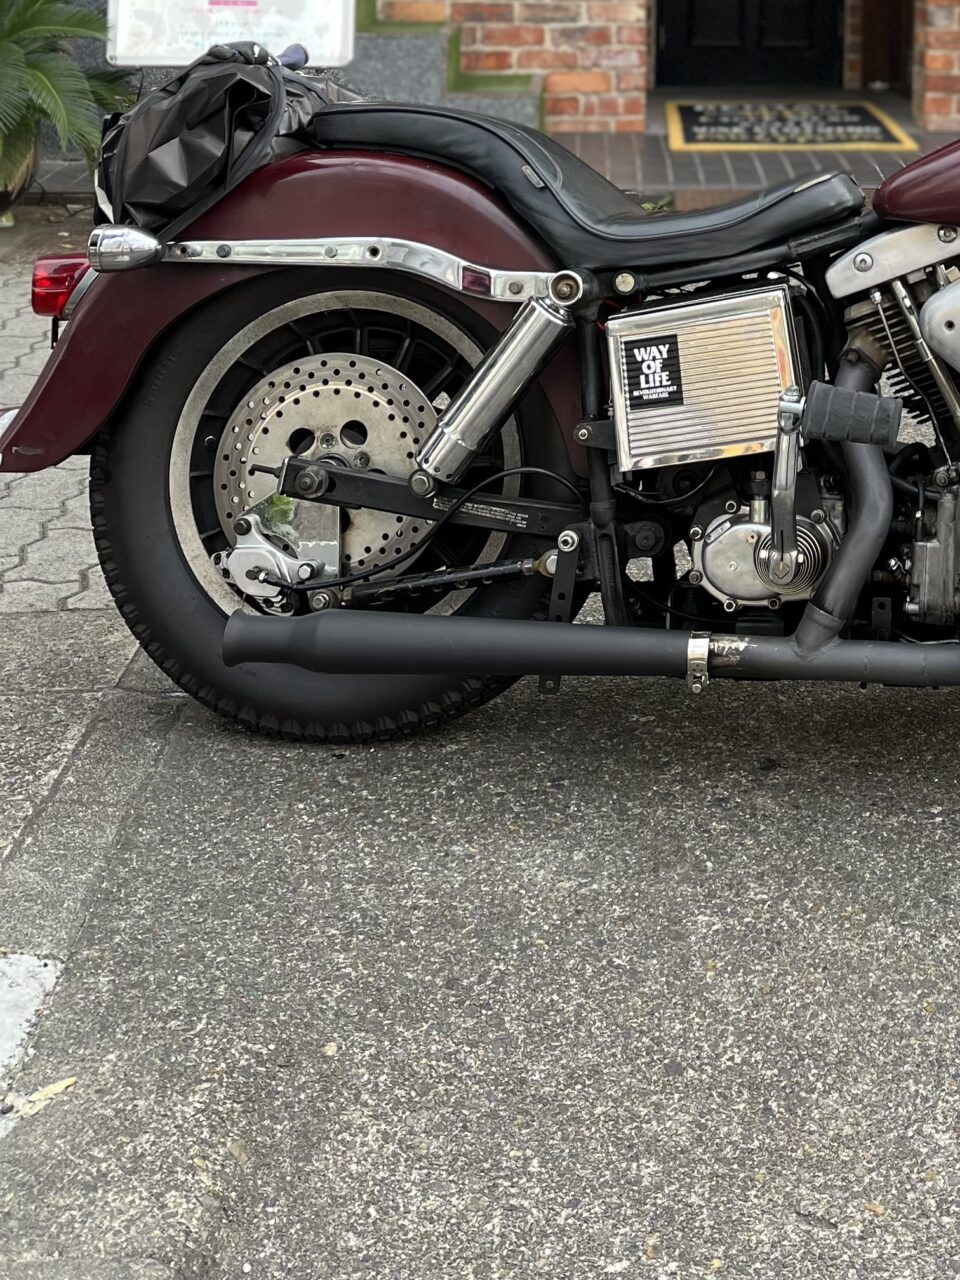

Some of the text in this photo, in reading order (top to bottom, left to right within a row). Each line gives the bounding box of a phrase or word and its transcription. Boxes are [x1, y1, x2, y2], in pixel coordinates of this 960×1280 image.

[633, 344, 669, 361] WAY
[641, 359, 663, 374] OF
[640, 371, 671, 388] LIFE
[633, 386, 677, 396] REVOLUTIONARY
